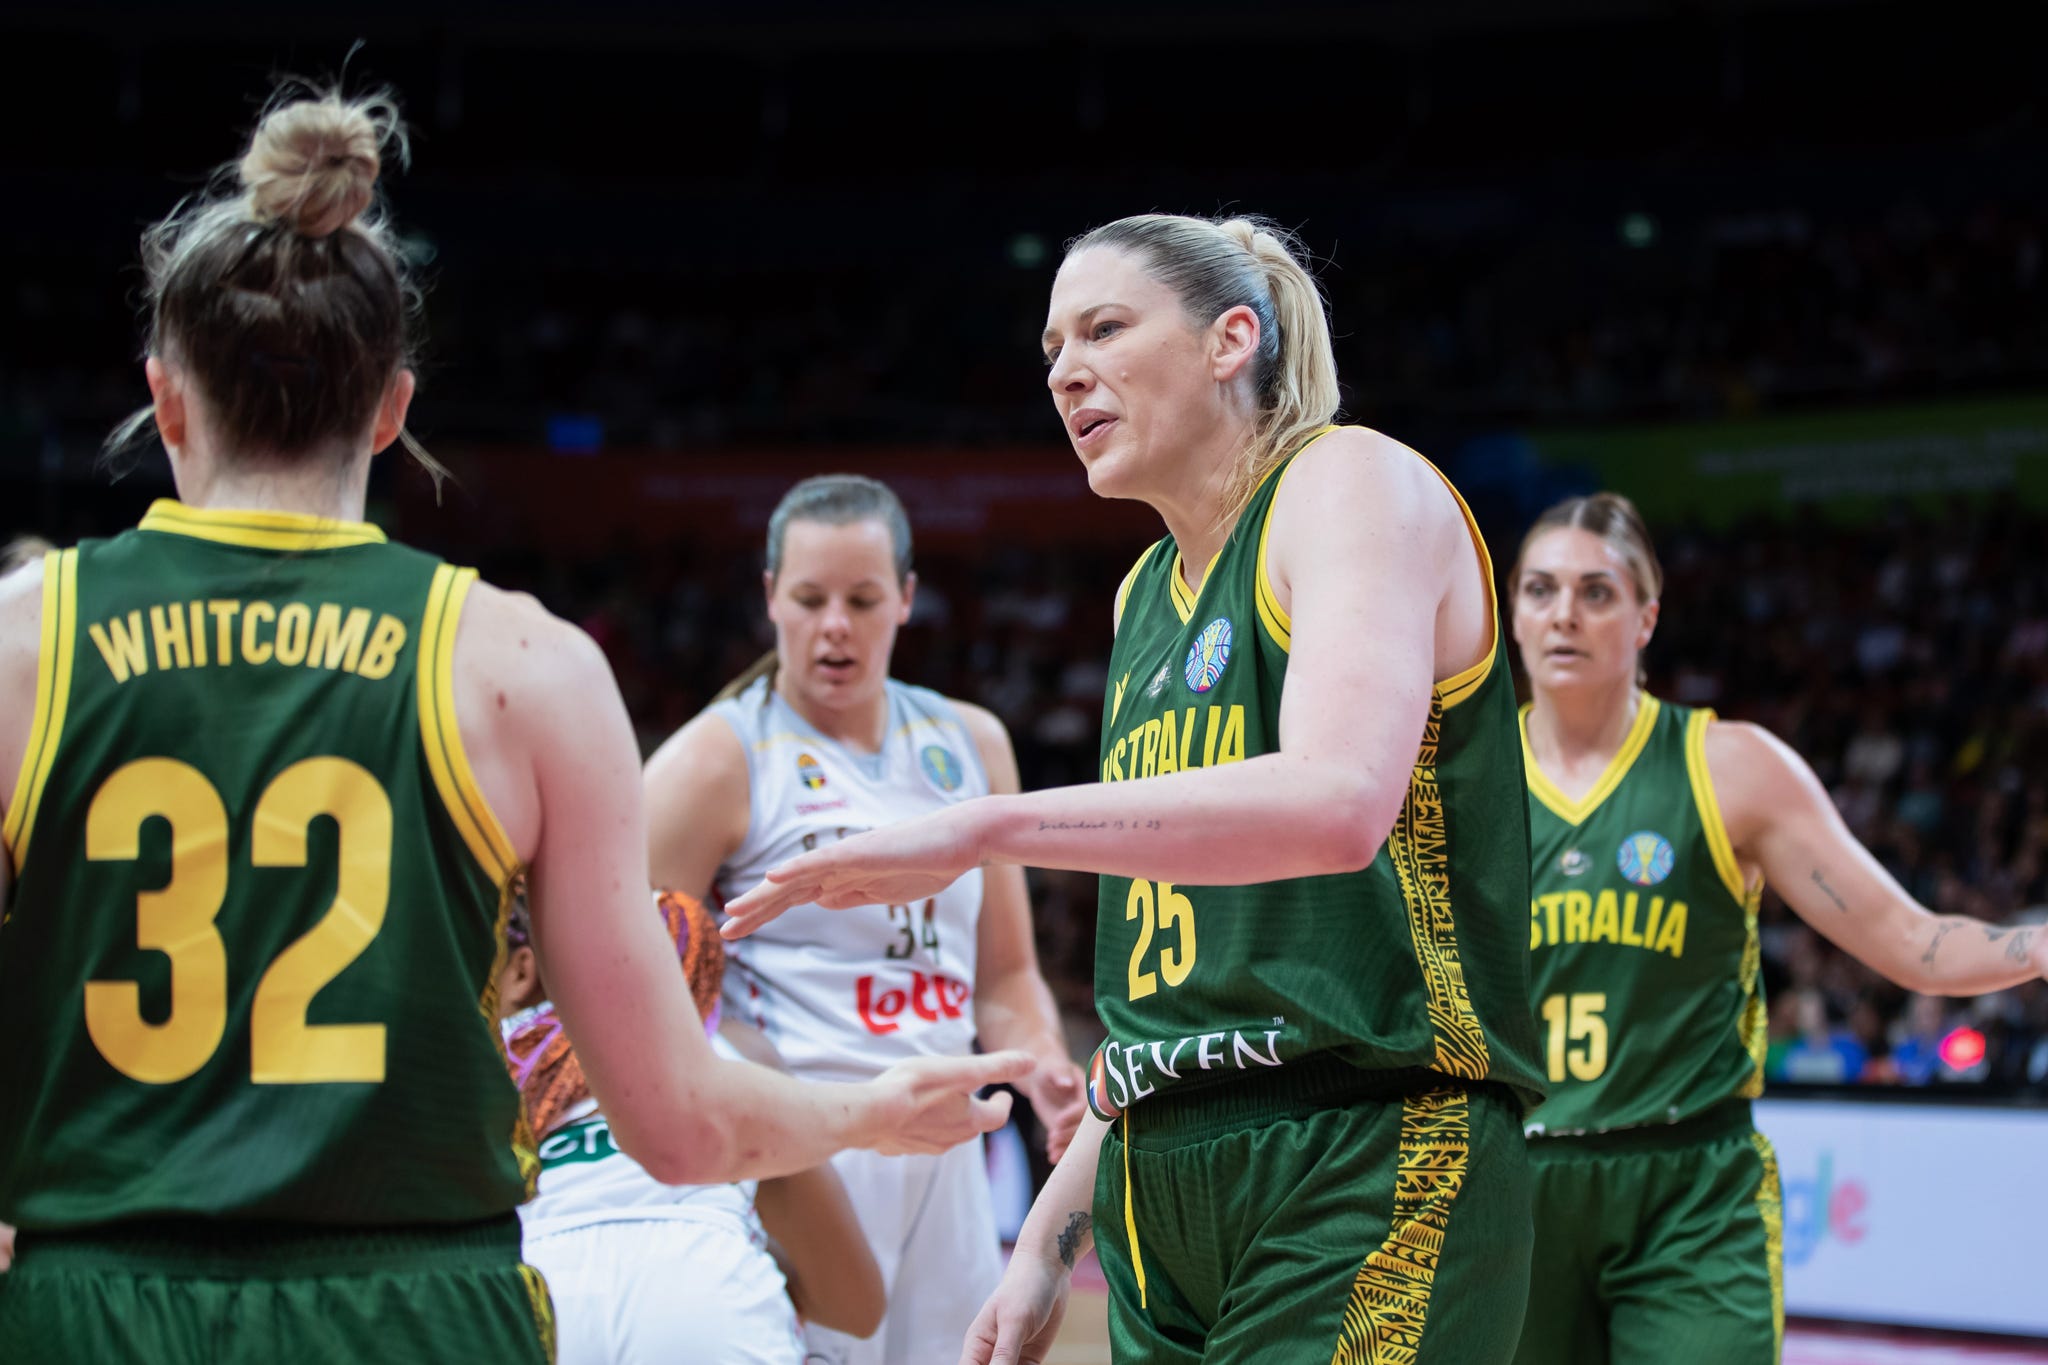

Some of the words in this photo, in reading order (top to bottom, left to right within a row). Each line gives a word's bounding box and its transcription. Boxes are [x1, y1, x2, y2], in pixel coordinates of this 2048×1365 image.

[89, 600, 407, 684] WHITCOMB
[1103, 704, 1245, 784] USTRALIA
[84, 755, 394, 1085] 32
[1126, 877, 1197, 1002] 25
[1530, 889, 1689, 959] STRALIA
[1105, 1029, 1284, 1108] SEVEN
[1541, 992, 1608, 1083] 15
[1783, 1149, 1868, 1268] gle
